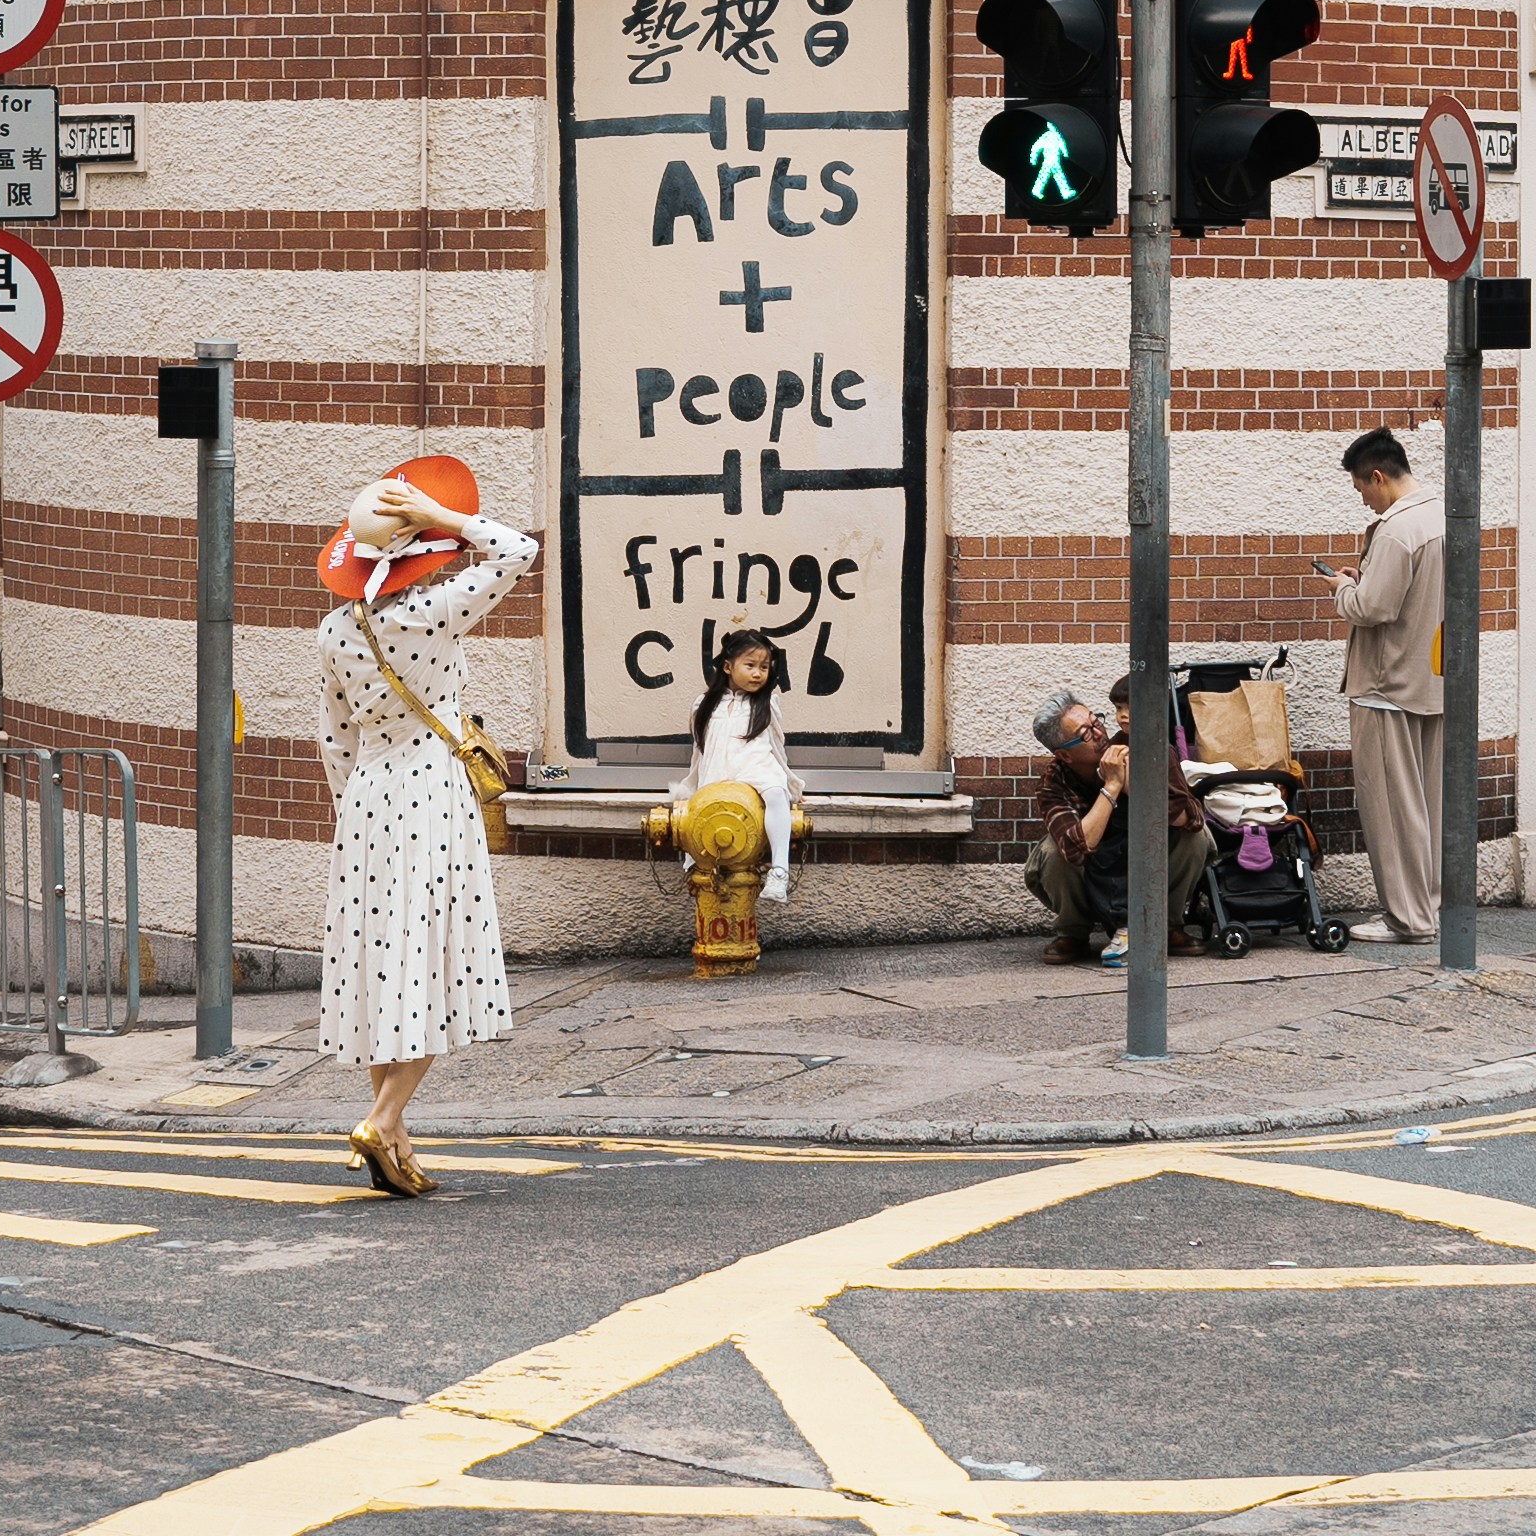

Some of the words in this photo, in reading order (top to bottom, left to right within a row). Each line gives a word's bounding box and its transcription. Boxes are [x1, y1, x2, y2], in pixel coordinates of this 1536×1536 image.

[0, 94, 33, 114] for
[66, 126, 132, 150] STREET
[1341, 129, 1421, 155] ALBER
[651, 157, 859, 247] Arts
